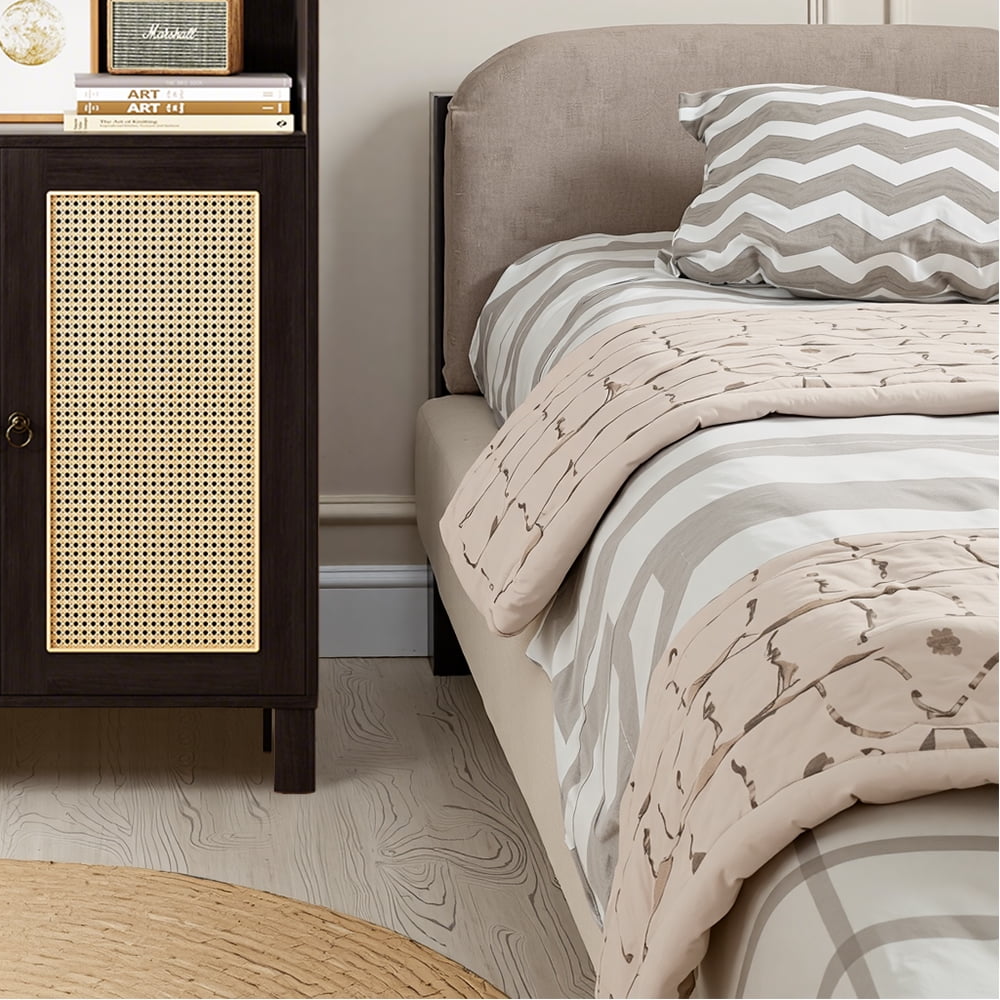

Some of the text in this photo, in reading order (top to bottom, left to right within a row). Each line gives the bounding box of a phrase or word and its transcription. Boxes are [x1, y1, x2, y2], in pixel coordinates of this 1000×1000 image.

[142, 24, 198, 40] Marshall
[128, 90, 160, 99] ART
[127, 104, 160, 113] ART
